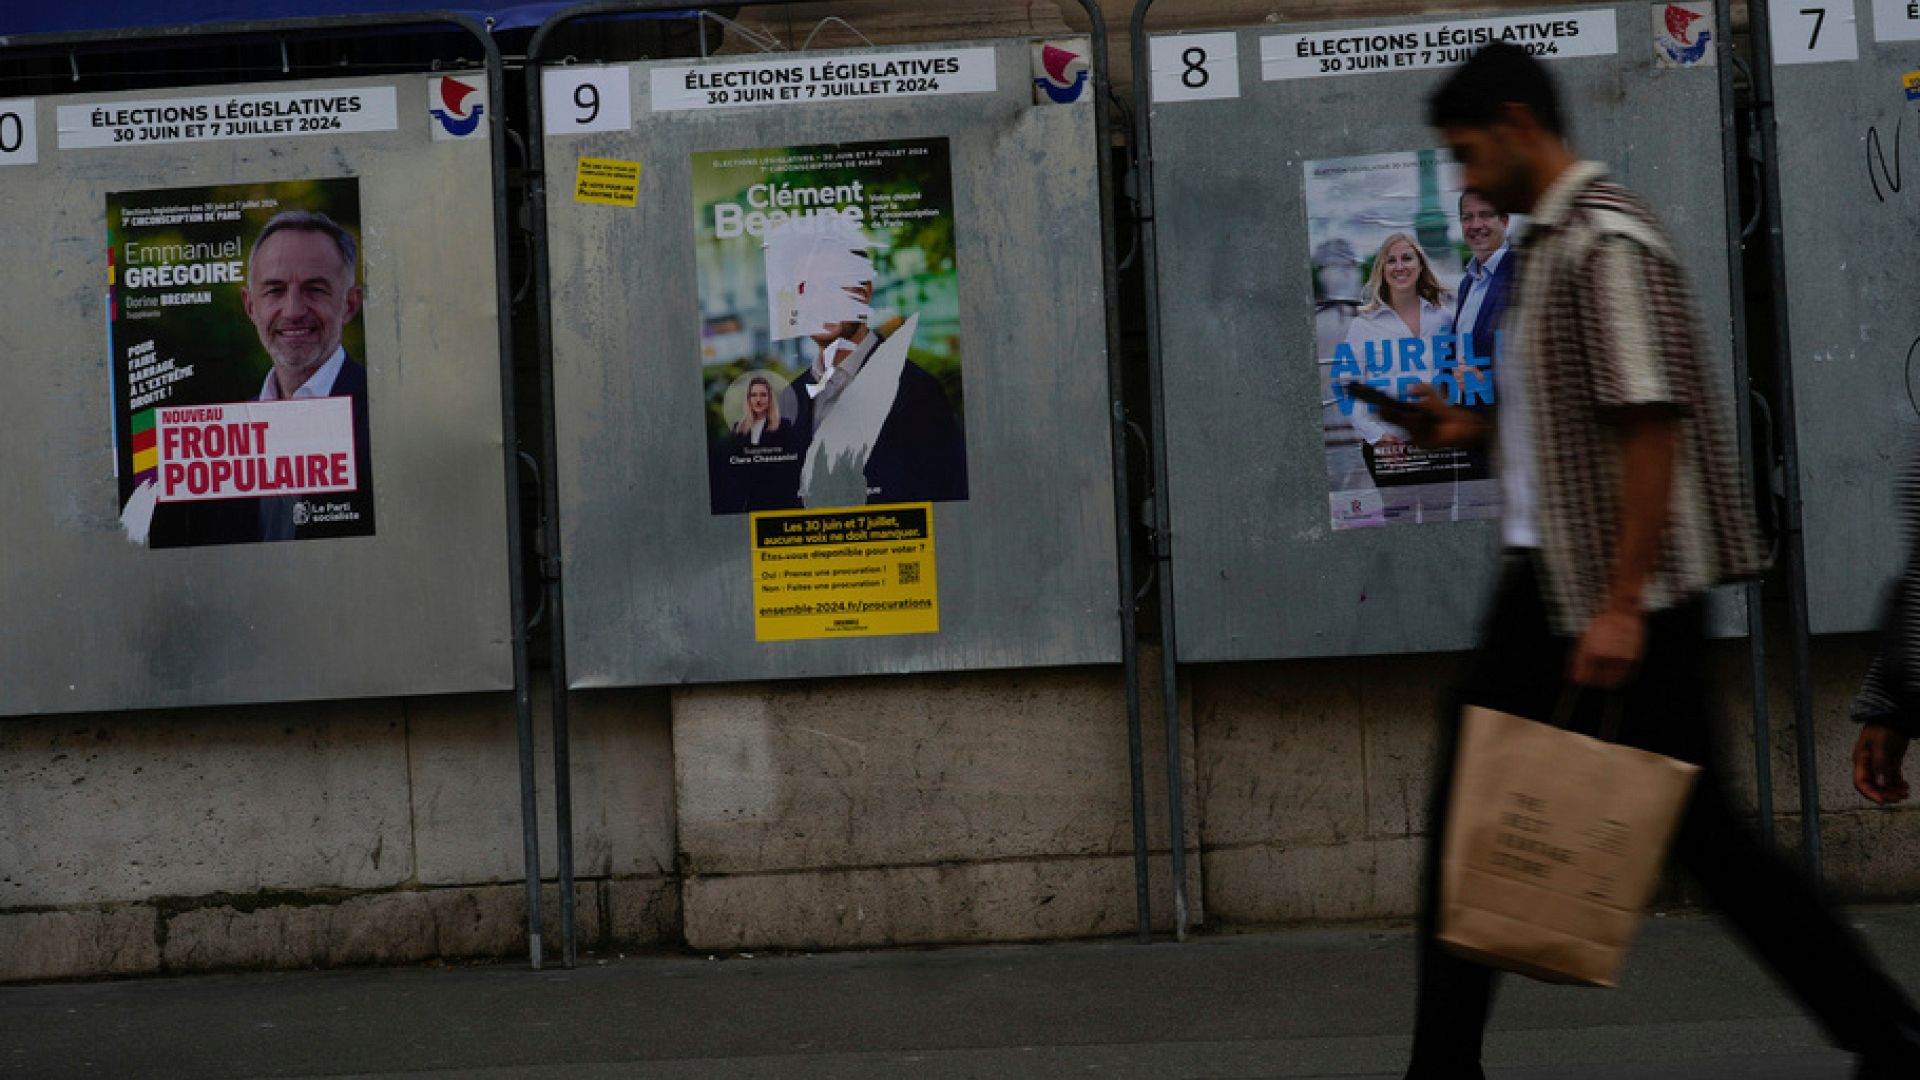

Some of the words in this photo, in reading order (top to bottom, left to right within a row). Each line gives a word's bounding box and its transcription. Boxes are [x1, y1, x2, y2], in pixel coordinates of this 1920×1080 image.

[1296, 32, 1418, 60] ÉLECTIONS
[1424, 20, 1579, 48] LÉGISLATIVES
[1799, 8, 1825, 50] 7
[1180, 46, 1210, 89] 8
[1319, 58, 1341, 73] 30
[1346, 54, 1388, 71] JUIN
[1394, 52, 1416, 67] ET
[1420, 51, 1431, 65] 7
[1520, 40, 1559, 57] 024
[685, 65, 803, 91] ÉLECTIONS
[809, 59, 960, 82] LÉGISLATIVES
[572, 82, 601, 125] 9
[706, 89, 728, 105] 30
[733, 87, 774, 104] JUIN
[780, 85, 802, 101] ET
[806, 84, 816, 99] 7
[820, 81, 890, 99] JUILLET
[896, 77, 940, 94] 2024
[92, 105, 208, 128] ÉLECTIONS
[215, 95, 361, 120] LÉGISLATIVES
[113, 128, 135, 143] 30
[140, 125, 179, 141] JUIN
[185, 124, 205, 139] ET
[210, 122, 220, 137] 7
[225, 119, 293, 137] JUILLET
[299, 115, 342, 133] 2024
[747, 179, 864, 209] Clément
[125, 236, 242, 265] Emmanuel
[125, 258, 244, 289] GRÉGOIRE
[162, 407, 224, 425] NOUVEAU
[162, 421, 269, 460] FRONT
[164, 452, 350, 497] POPULAIRE
[763, 535, 803, 546] aucune
[805, 532, 828, 544] voix
[830, 532, 844, 543] ne
[846, 529, 868, 541] doit
[783, 520, 803, 533] Les
[805, 519, 820, 531] 30
[822, 517, 843, 533] juin
[845, 517, 856, 529] et
[857, 516, 867, 528] 7
[811, 547, 863, 561] disponible
[865, 546, 889, 559] pour
[891, 544, 917, 555] voter
[760, 570, 777, 580] Oui
[814, 568, 830, 577] une
[832, 565, 881, 578] procuration
[761, 584, 780, 593] Non
[814, 582, 830, 590] une
[831, 579, 881, 591] procuration
